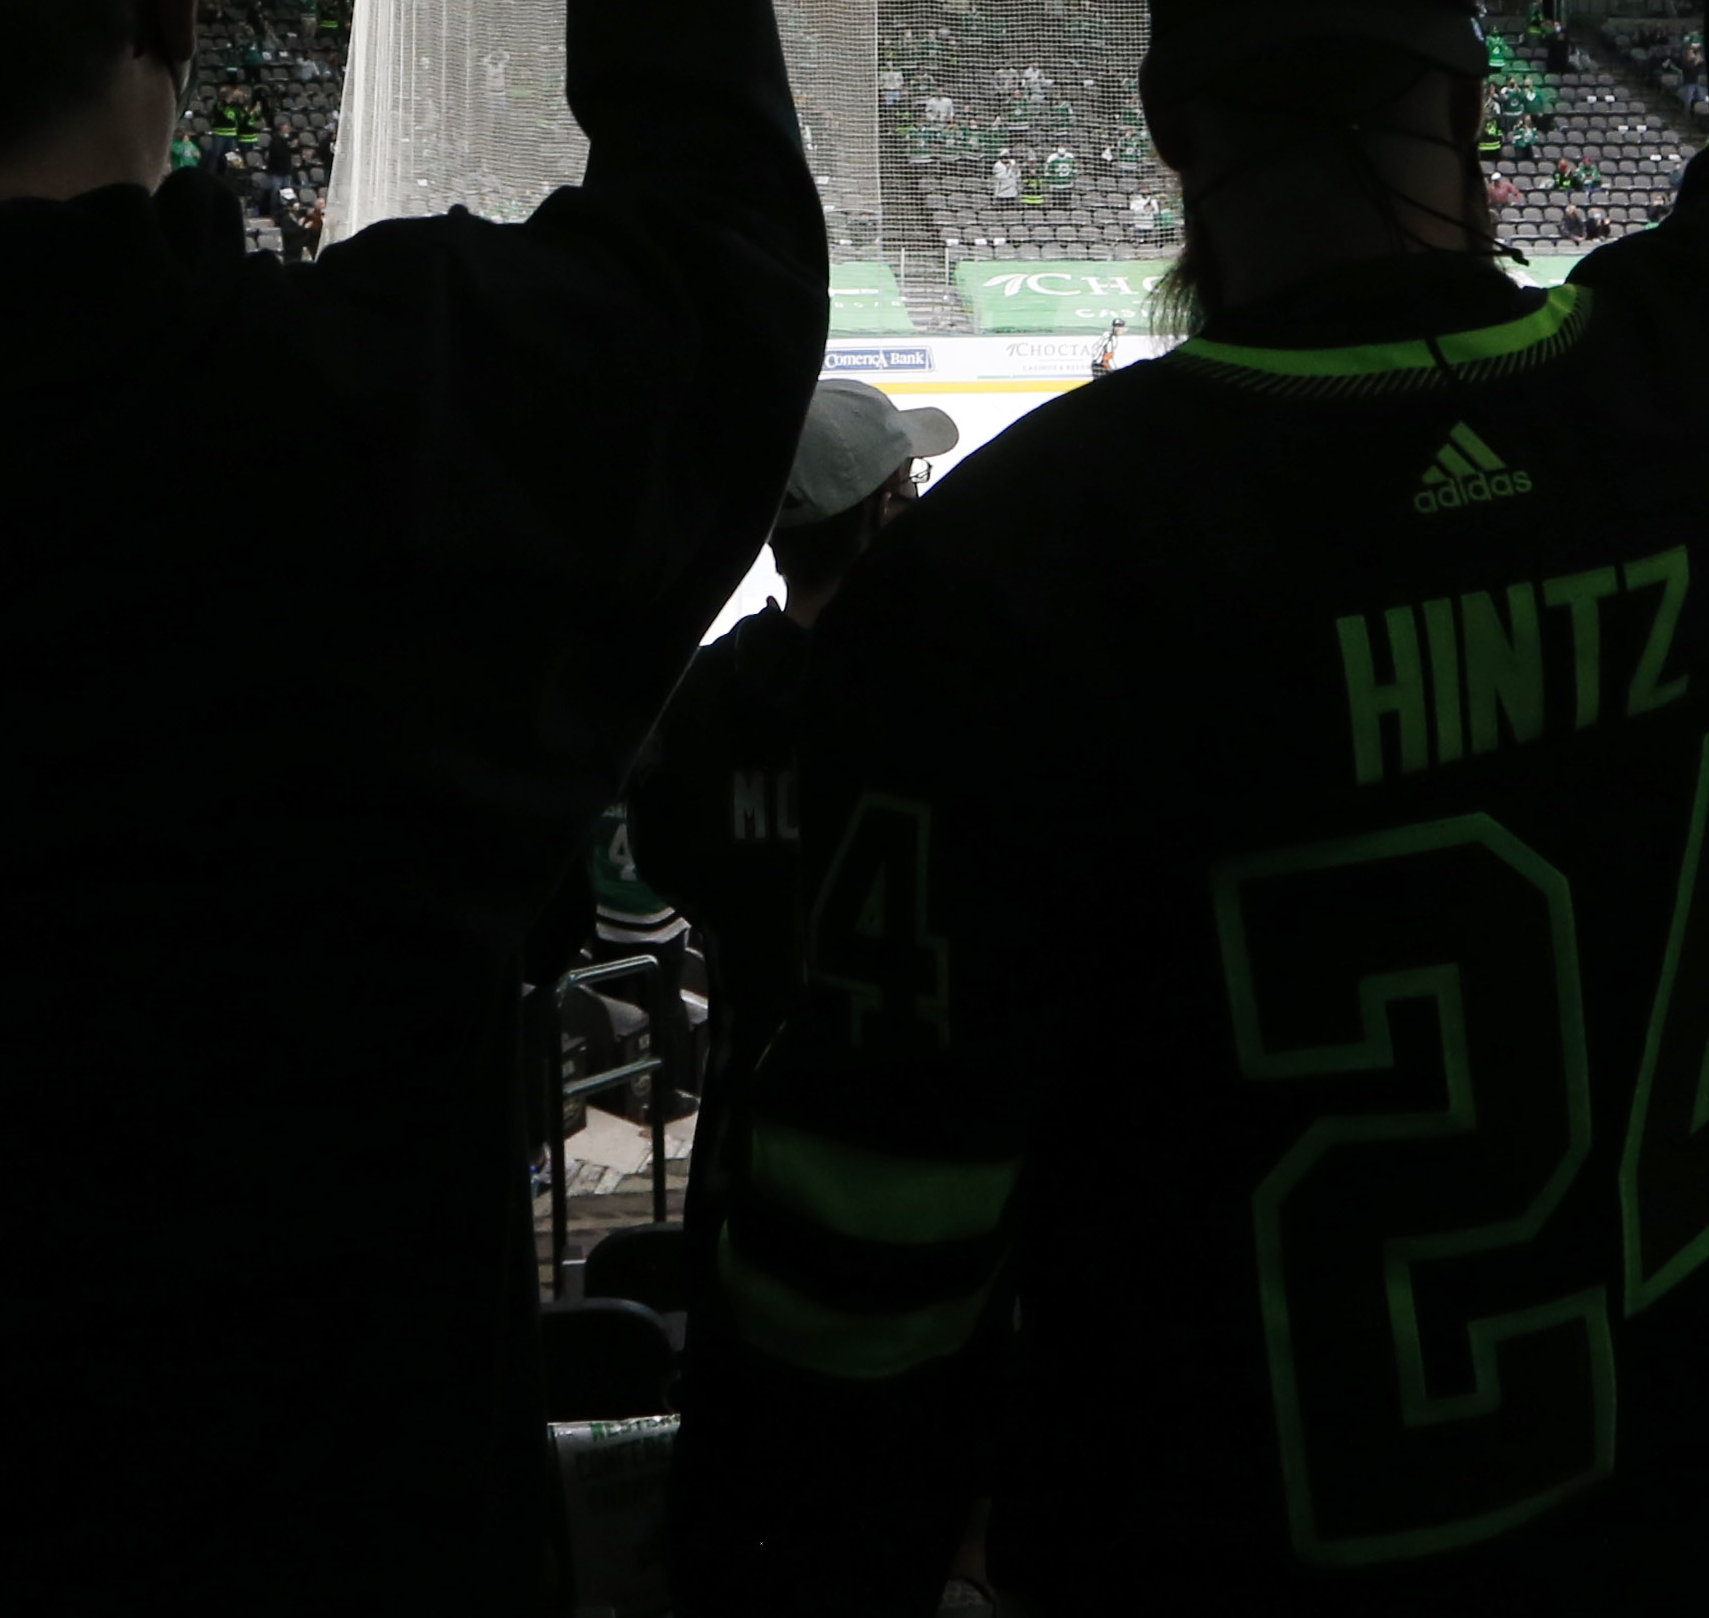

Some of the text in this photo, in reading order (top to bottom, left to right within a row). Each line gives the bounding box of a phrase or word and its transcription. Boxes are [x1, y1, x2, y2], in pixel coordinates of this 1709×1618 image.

[890, 351, 926, 368] Bank
[1019, 342, 1092, 359] CHOCTA
[1412, 465, 1534, 516] adidas
[1334, 542, 1692, 786] HINTZ
